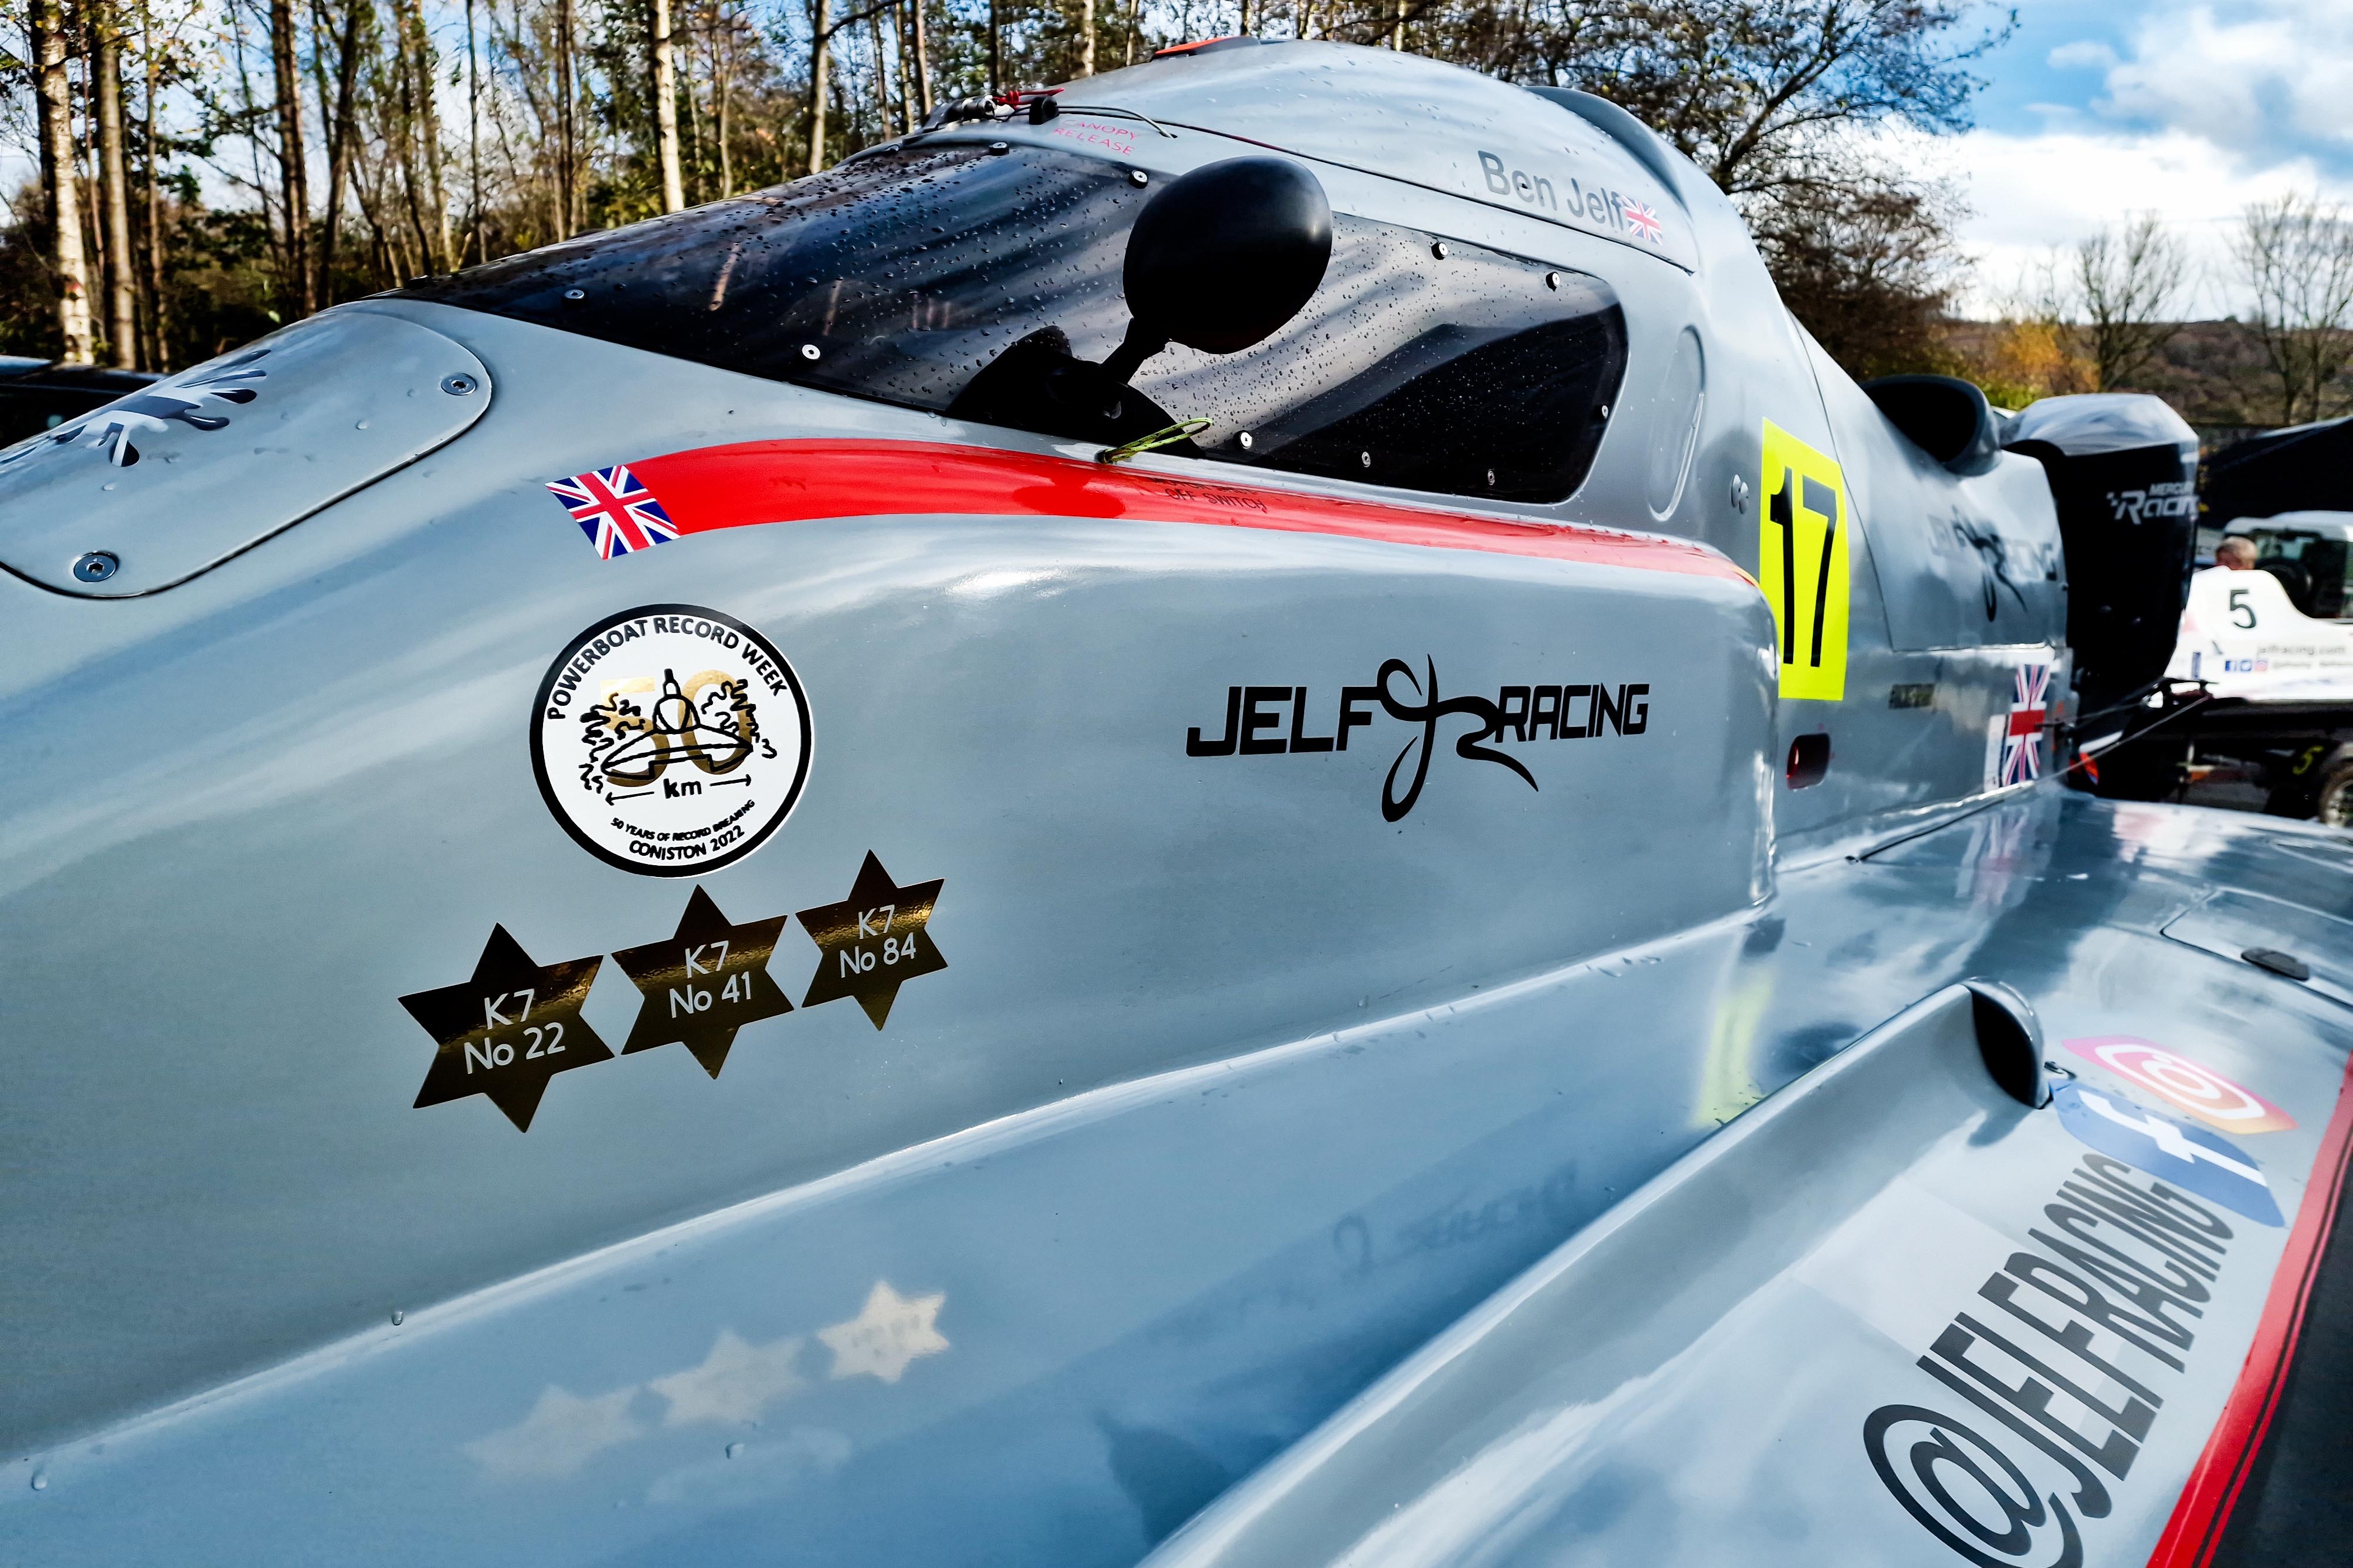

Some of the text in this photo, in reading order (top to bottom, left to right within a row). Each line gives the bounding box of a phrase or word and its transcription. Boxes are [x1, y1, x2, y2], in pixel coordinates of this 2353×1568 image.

[1053, 127, 1135, 155] RELEASE
[1062, 119, 1139, 140] CANOPY
[1478, 150, 1624, 231] Ben Jelf
[1165, 488, 1268, 511] OFF SWITCH
[1770, 466, 1838, 668] 17
[2229, 589, 2257, 629] 5
[547, 616, 788, 720] POWERBOAT RECORD WEEK
[1186, 686, 1381, 757] JELF
[1495, 682, 1650, 743] RACING
[663, 778, 702, 799] km
[610, 817, 624, 829] 50
[625, 823, 655, 840] YEARS
[656, 832, 671, 842] OF
[672, 827, 711, 841] RECORD
[629, 825, 745, 860] CONISTON 2022
[858, 904, 895, 940] K7
[685, 940, 729, 979] K7
[839, 932, 916, 978] No 84
[484, 988, 535, 1030] K7
[669, 971, 751, 1019] No 41
[464, 1022, 566, 1075] No 22
[1863, 1153, 2234, 1568] @JELFRACING
